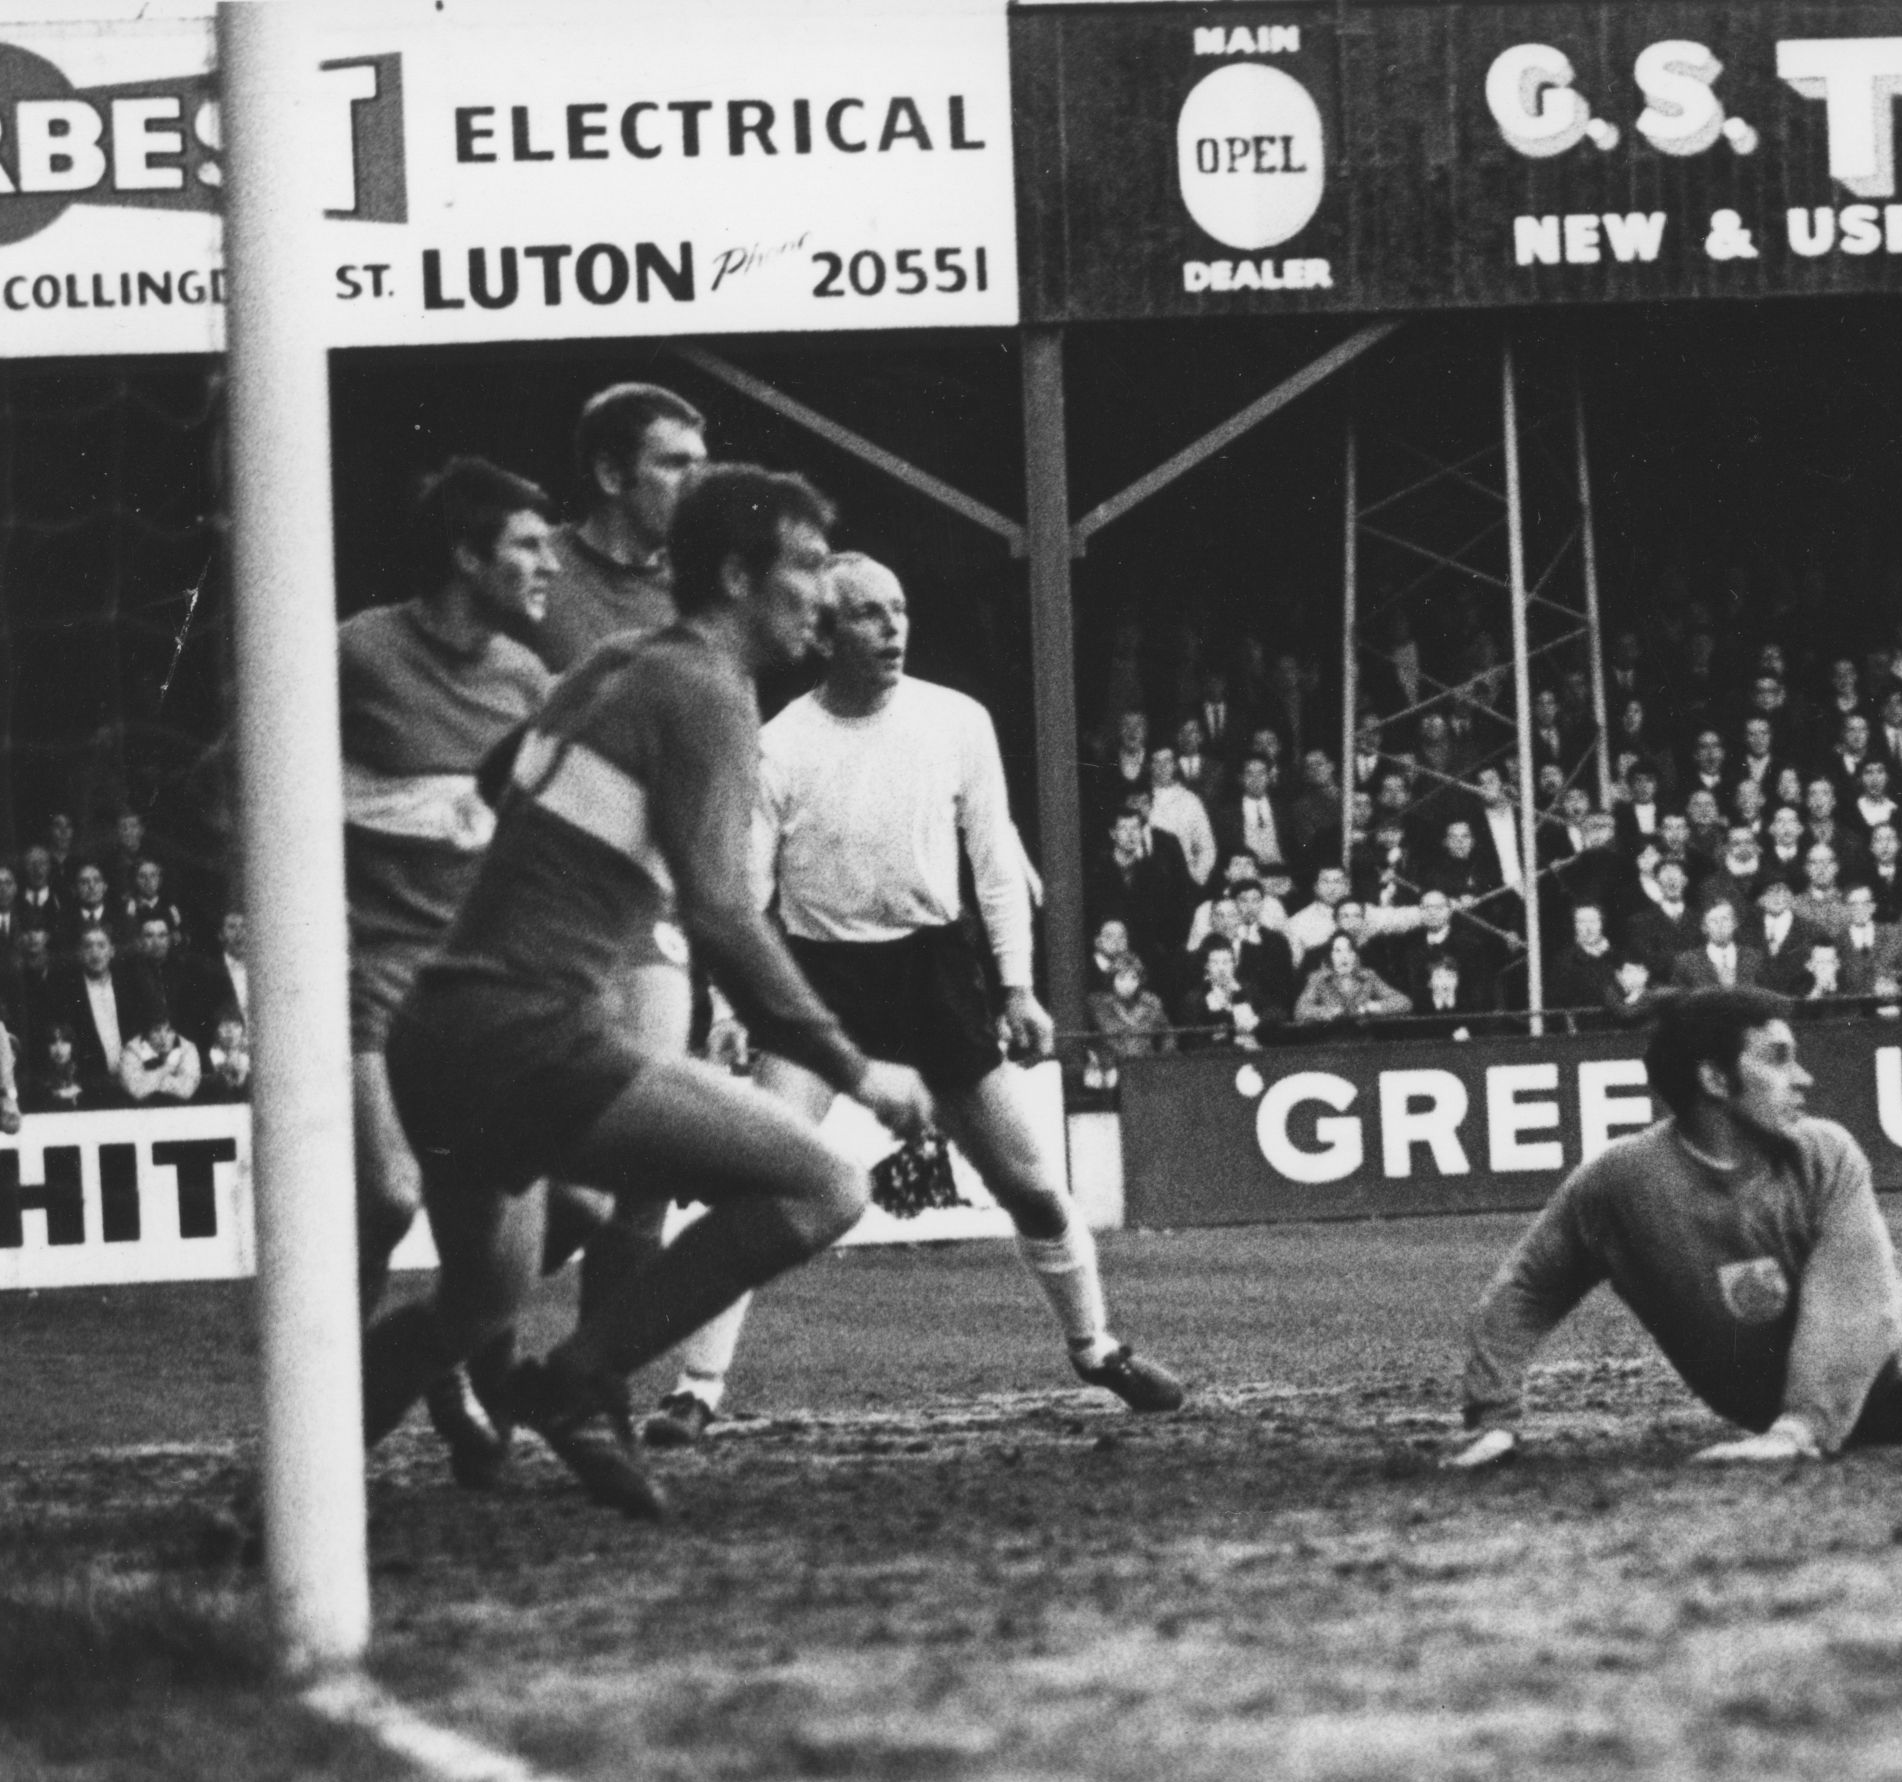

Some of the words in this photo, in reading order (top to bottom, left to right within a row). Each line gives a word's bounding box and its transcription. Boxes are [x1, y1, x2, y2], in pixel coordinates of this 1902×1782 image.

[1193, 25, 1301, 56] MAIN
[455, 95, 985, 163] ELECTRICAL
[1485, 39, 1759, 158] G.S.
[1196, 135, 1307, 174] OPEL
[1513, 211, 1667, 266] NEW
[1704, 208, 1759, 261] &
[335, 264, 395, 300] ST.
[422, 241, 695, 311] LUTON
[812, 247, 987, 298] 20551
[1182, 257, 1334, 293] DEALER
[1235, 1058, 1654, 1184] 'GREE
[0, 1137, 237, 1249] HIT
